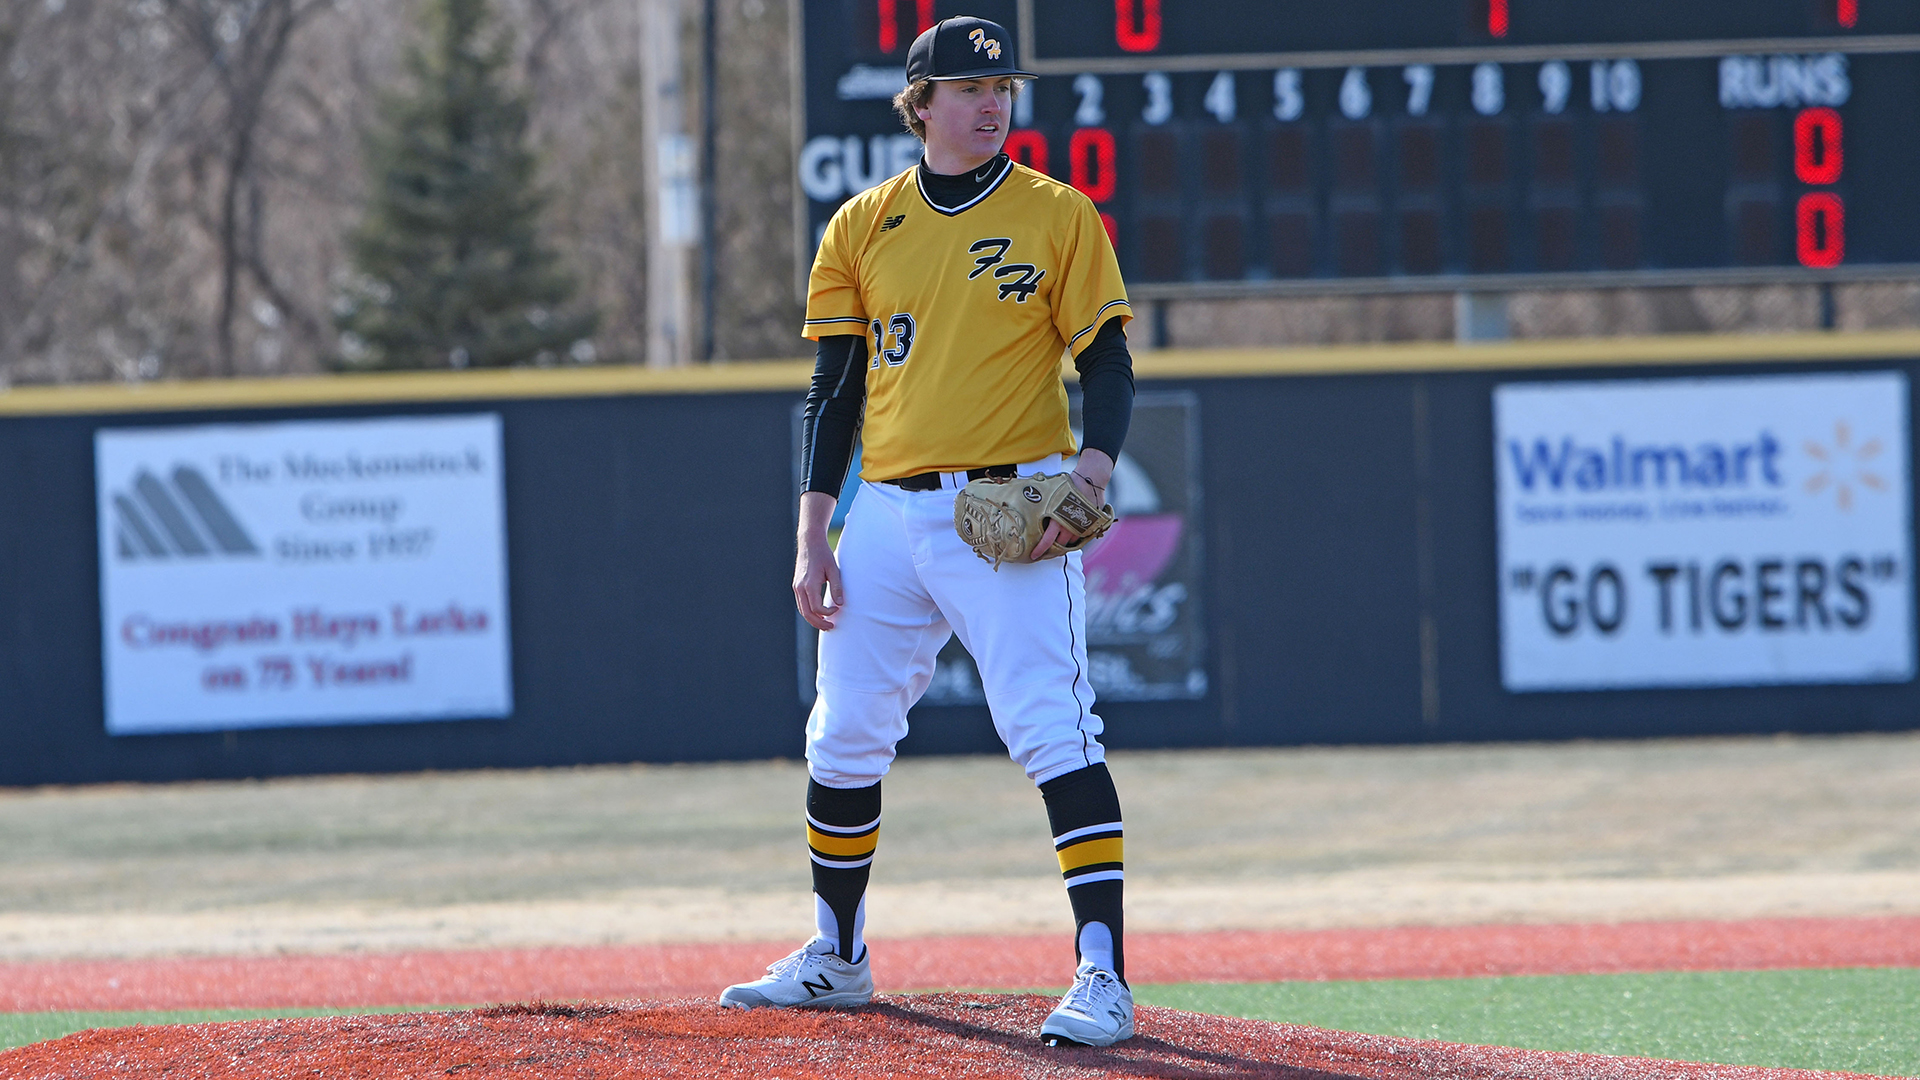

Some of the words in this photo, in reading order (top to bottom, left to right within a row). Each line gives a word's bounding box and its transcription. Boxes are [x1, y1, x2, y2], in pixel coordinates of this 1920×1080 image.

[1072, 72, 1105, 126] 2
[1142, 70, 1174, 125] 3
[1203, 69, 1236, 124] 4
[1273, 67, 1305, 121] 5
[1339, 66, 1372, 120] 6
[1403, 64, 1434, 115] 7
[1472, 61, 1504, 115] 8
[1539, 59, 1571, 114] 9
[1590, 58, 1641, 112] 10
[1718, 53, 1851, 109] RUNS
[799, 134, 926, 202] GUE
[1070, 128, 1116, 203] 0
[1794, 107, 1843, 184] 0
[1797, 191, 1845, 268] 0
[216, 455, 272, 483] The
[1509, 430, 1784, 492] Walmart
[301, 492, 401, 524] Group
[275, 534, 356, 561] Since
[121, 612, 280, 651] Congrats
[291, 606, 379, 648] Hays
[391, 601, 489, 636] Larks
[1511, 562, 1629, 638] "GO
[1645, 554, 1897, 634] TIGERS"
[202, 666, 246, 692] on
